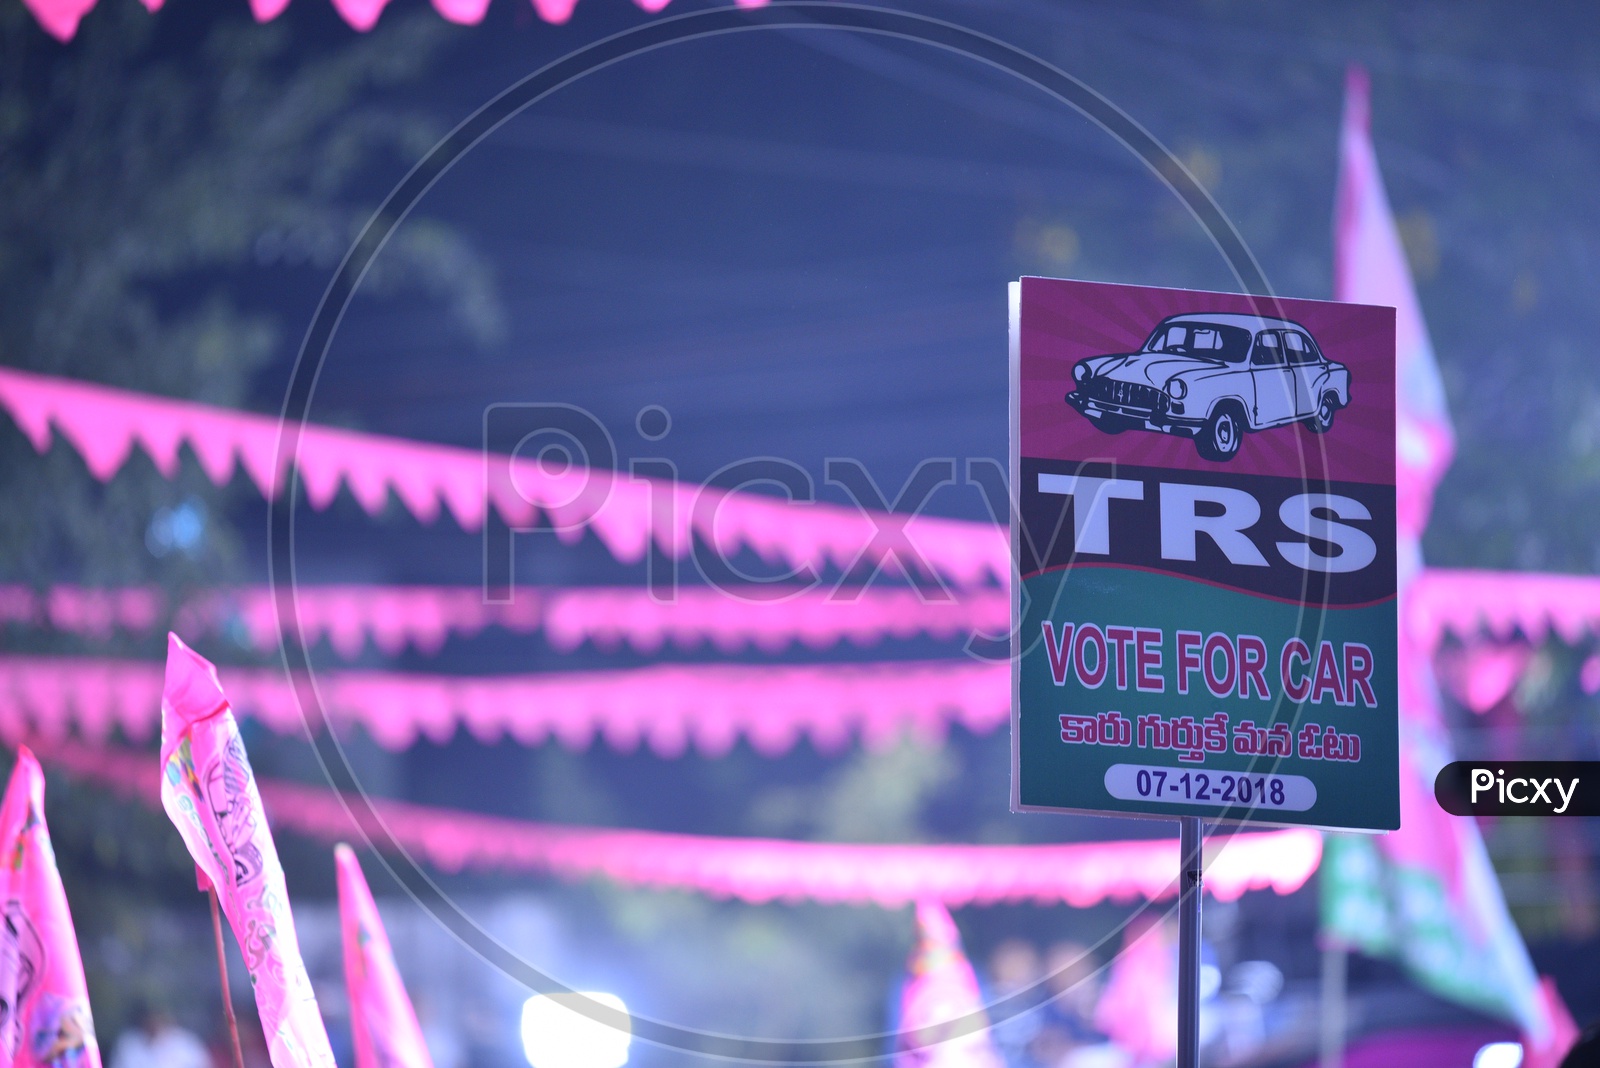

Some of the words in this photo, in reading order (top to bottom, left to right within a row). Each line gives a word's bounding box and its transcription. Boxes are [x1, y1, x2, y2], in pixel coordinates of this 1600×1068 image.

[1038, 473, 1377, 573] TRS
[1041, 620, 1164, 693] VOTE
[1176, 630, 1271, 700] FOR
[1280, 637, 1377, 708] CAR
[1059, 712, 1132, 747] కారు
[1137, 712, 1228, 763] గుర్తుకే
[1233, 720, 1292, 757] మన
[1298, 723, 1361, 762] ఓటు
[1136, 769, 1285, 806] 07-12-2018
